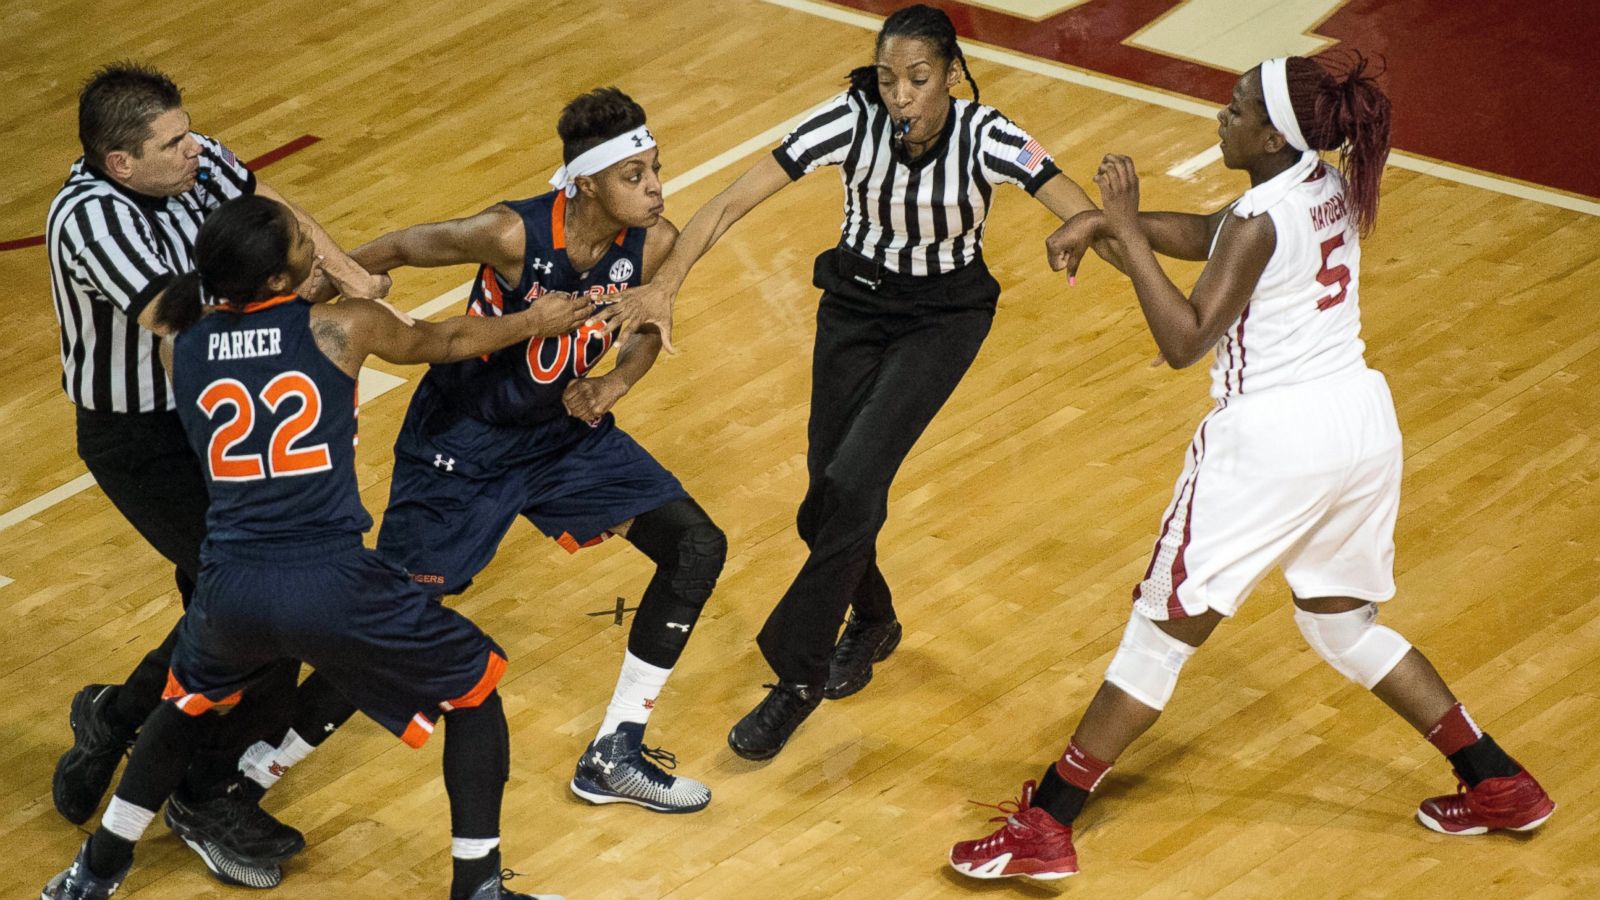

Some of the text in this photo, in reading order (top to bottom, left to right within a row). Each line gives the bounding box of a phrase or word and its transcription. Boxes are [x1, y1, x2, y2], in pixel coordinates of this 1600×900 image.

[1310, 192, 1347, 232] HAYDEN
[610, 259, 632, 281] SEC
[1315, 230, 1351, 312] 5
[207, 327, 282, 361] PARKER
[196, 370, 333, 482] 22
